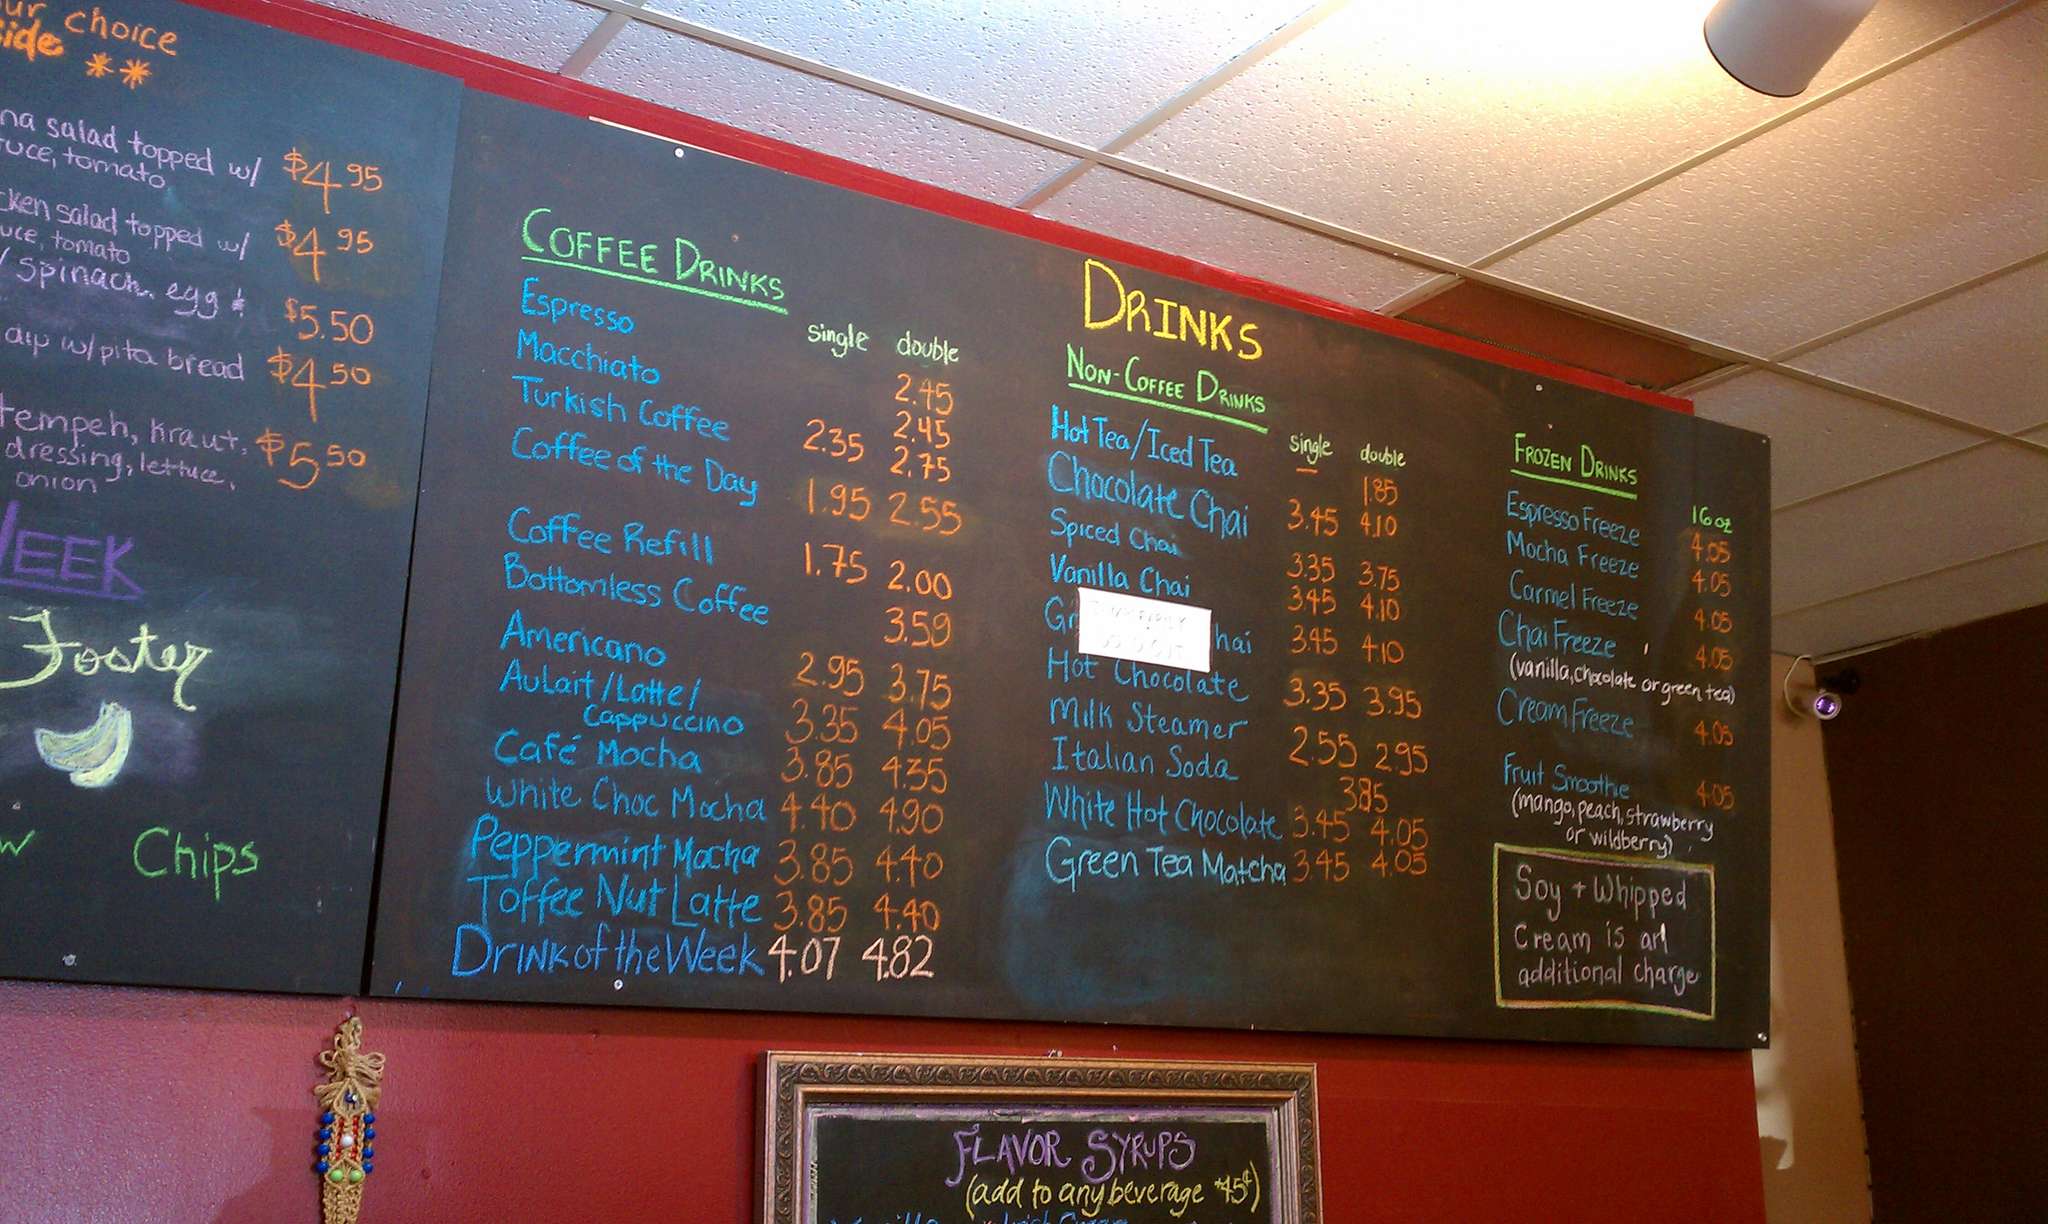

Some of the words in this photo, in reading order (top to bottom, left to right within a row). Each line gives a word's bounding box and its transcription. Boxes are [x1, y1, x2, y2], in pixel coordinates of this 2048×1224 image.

[64, 7, 177, 56] choice
[47, 120, 119, 153] salad
[128, 130, 214, 175] topped
[63, 147, 165, 188] tomato
[51, 230, 130, 264] tomato
[56, 204, 117, 236] salad
[126, 212, 203, 251] topped
[521, 208, 659, 274] COFFEE
[675, 238, 784, 300] DRINKS
[166, 283, 219, 319] egg
[285, 298, 374, 344] $5.50
[521, 277, 635, 335] Espresso
[1082, 258, 1264, 361] DRINKS
[167, 348, 244, 382] bread
[807, 324, 870, 358] single
[896, 331, 960, 363] double
[516, 329, 660, 385] Macchiato
[894, 374, 954, 416] 2.45
[1065, 343, 1185, 401] NON-COFFEE
[1197, 369, 1267, 414] DRINKS
[512, 376, 628, 424] Turkish
[639, 400, 730, 442] Coffee
[803, 420, 864, 462] 2.35
[892, 411, 951, 449] 2.45
[1050, 403, 1089, 444] Hot
[1197, 438, 1239, 479] Tea
[1289, 433, 1333, 466] single
[1359, 443, 1407, 468] double
[16, 470, 97, 493] onion
[512, 427, 610, 472] Coffee
[617, 446, 648, 474] of
[652, 454, 696, 485] the
[704, 458, 759, 506] Day
[889, 445, 950, 483] 2.75
[1514, 433, 1572, 472] FROZEN
[1581, 444, 1638, 485] DRINKS
[805, 474, 871, 521] 1.95
[888, 492, 962, 535] 2.55
[1047, 450, 1186, 520] Chocolate
[1190, 488, 1249, 539] Chai
[1506, 490, 1579, 532] Espresso
[1583, 506, 1641, 547] Freeze
[507, 507, 613, 554] Coffee
[622, 522, 714, 565] Refill
[803, 542, 868, 584] 1.75
[887, 560, 953, 600] 2.00
[1050, 507, 1121, 548] Spiced
[1128, 526, 1184, 558] Chai
[1287, 499, 1340, 537] 3.45
[1359, 508, 1397, 539] 4.10
[1506, 530, 1569, 566] Mocha
[1577, 544, 1640, 579] Freeze
[503, 551, 664, 608] Bottomless
[673, 578, 769, 625] Coffee
[883, 607, 952, 648] 3.59
[1049, 552, 1129, 590] Vanilla
[1140, 566, 1192, 599] Chai
[1286, 552, 1336, 583] 3.35
[1358, 560, 1401, 592] 3.75
[1510, 569, 1577, 609] Carmel
[1583, 587, 1640, 620] Freeze
[1691, 569, 1732, 597] 4.05
[1359, 593, 1400, 623] 4.10
[1498, 608, 1548, 652] Chai
[1553, 619, 1617, 658] Freeze
[1694, 608, 1733, 633] 4.05
[500, 609, 667, 668] Americano
[795, 653, 865, 697] 2.95
[887, 664, 953, 710] 3.75
[1046, 647, 1098, 682] Hot
[1114, 657, 1249, 702] Chocolate
[1641, 678, 1659, 692] or
[1661, 682, 1702, 705] green
[582, 704, 745, 736] Cappuccino
[785, 699, 860, 746] 3.35
[882, 709, 951, 750] 4.05
[1050, 696, 1113, 730] Milk
[1126, 701, 1249, 740] Steamer
[1283, 677, 1348, 712] 3.35
[1363, 686, 1423, 719] 3.95
[1497, 687, 1568, 729] Cream
[1571, 697, 1634, 738] Freeze
[494, 729, 581, 768] Café
[597, 739, 703, 773] Mocha
[780, 746, 854, 789] 3.85
[880, 756, 948, 793] 4.35
[1050, 735, 1155, 778] Italian
[1165, 745, 1239, 781] Soda
[1289, 725, 1359, 769] 2.55
[1374, 741, 1429, 776] 2.95
[1504, 752, 1544, 785] Fruit
[485, 777, 582, 809] White
[592, 777, 660, 818] Choc
[671, 787, 767, 823] Mocha
[779, 792, 857, 832] 4.40
[879, 798, 945, 834] 4.90
[1043, 781, 1115, 832] White
[1126, 790, 1168, 834] Hot
[1174, 798, 1283, 841] Chocolate
[133, 827, 258, 900] Chips
[471, 813, 667, 880] Peppermint
[673, 838, 761, 876] Mocha
[773, 839, 854, 886] 3.85
[875, 843, 944, 887] 4.40
[1045, 836, 1138, 893] Green
[1145, 845, 1193, 880] Tea
[1203, 849, 1287, 887] Matcha
[1293, 806, 1350, 843] 3.45
[1369, 816, 1430, 851] 4.05
[1566, 826, 1586, 845] or
[1293, 848, 1351, 885] 3.45
[1371, 848, 1428, 878] 4.05
[1516, 864, 1561, 922] Soy
[1593, 873, 1687, 921] Whipped
[467, 874, 584, 926] Toffee
[595, 871, 664, 916] Nut
[672, 875, 763, 927] Latte
[773, 892, 848, 933] 3.85
[873, 896, 942, 933] 4.40
[573, 924, 610, 971] of
[614, 930, 660, 973] the
[664, 931, 766, 978] Week
[767, 935, 842, 984] 4.07
[862, 936, 935, 983] 4.82
[1514, 923, 1591, 953] Cream
[1606, 921, 1625, 947] is
[1518, 956, 1623, 987] additional
[1634, 956, 1699, 996] charge
[945, 1123, 1072, 1188] FLAVOR
[965, 1172, 1023, 1220] (add
[1031, 1179, 1052, 1204] to
[1058, 1181, 1105, 1218] any
[1107, 1179, 1205, 1217] beverage
